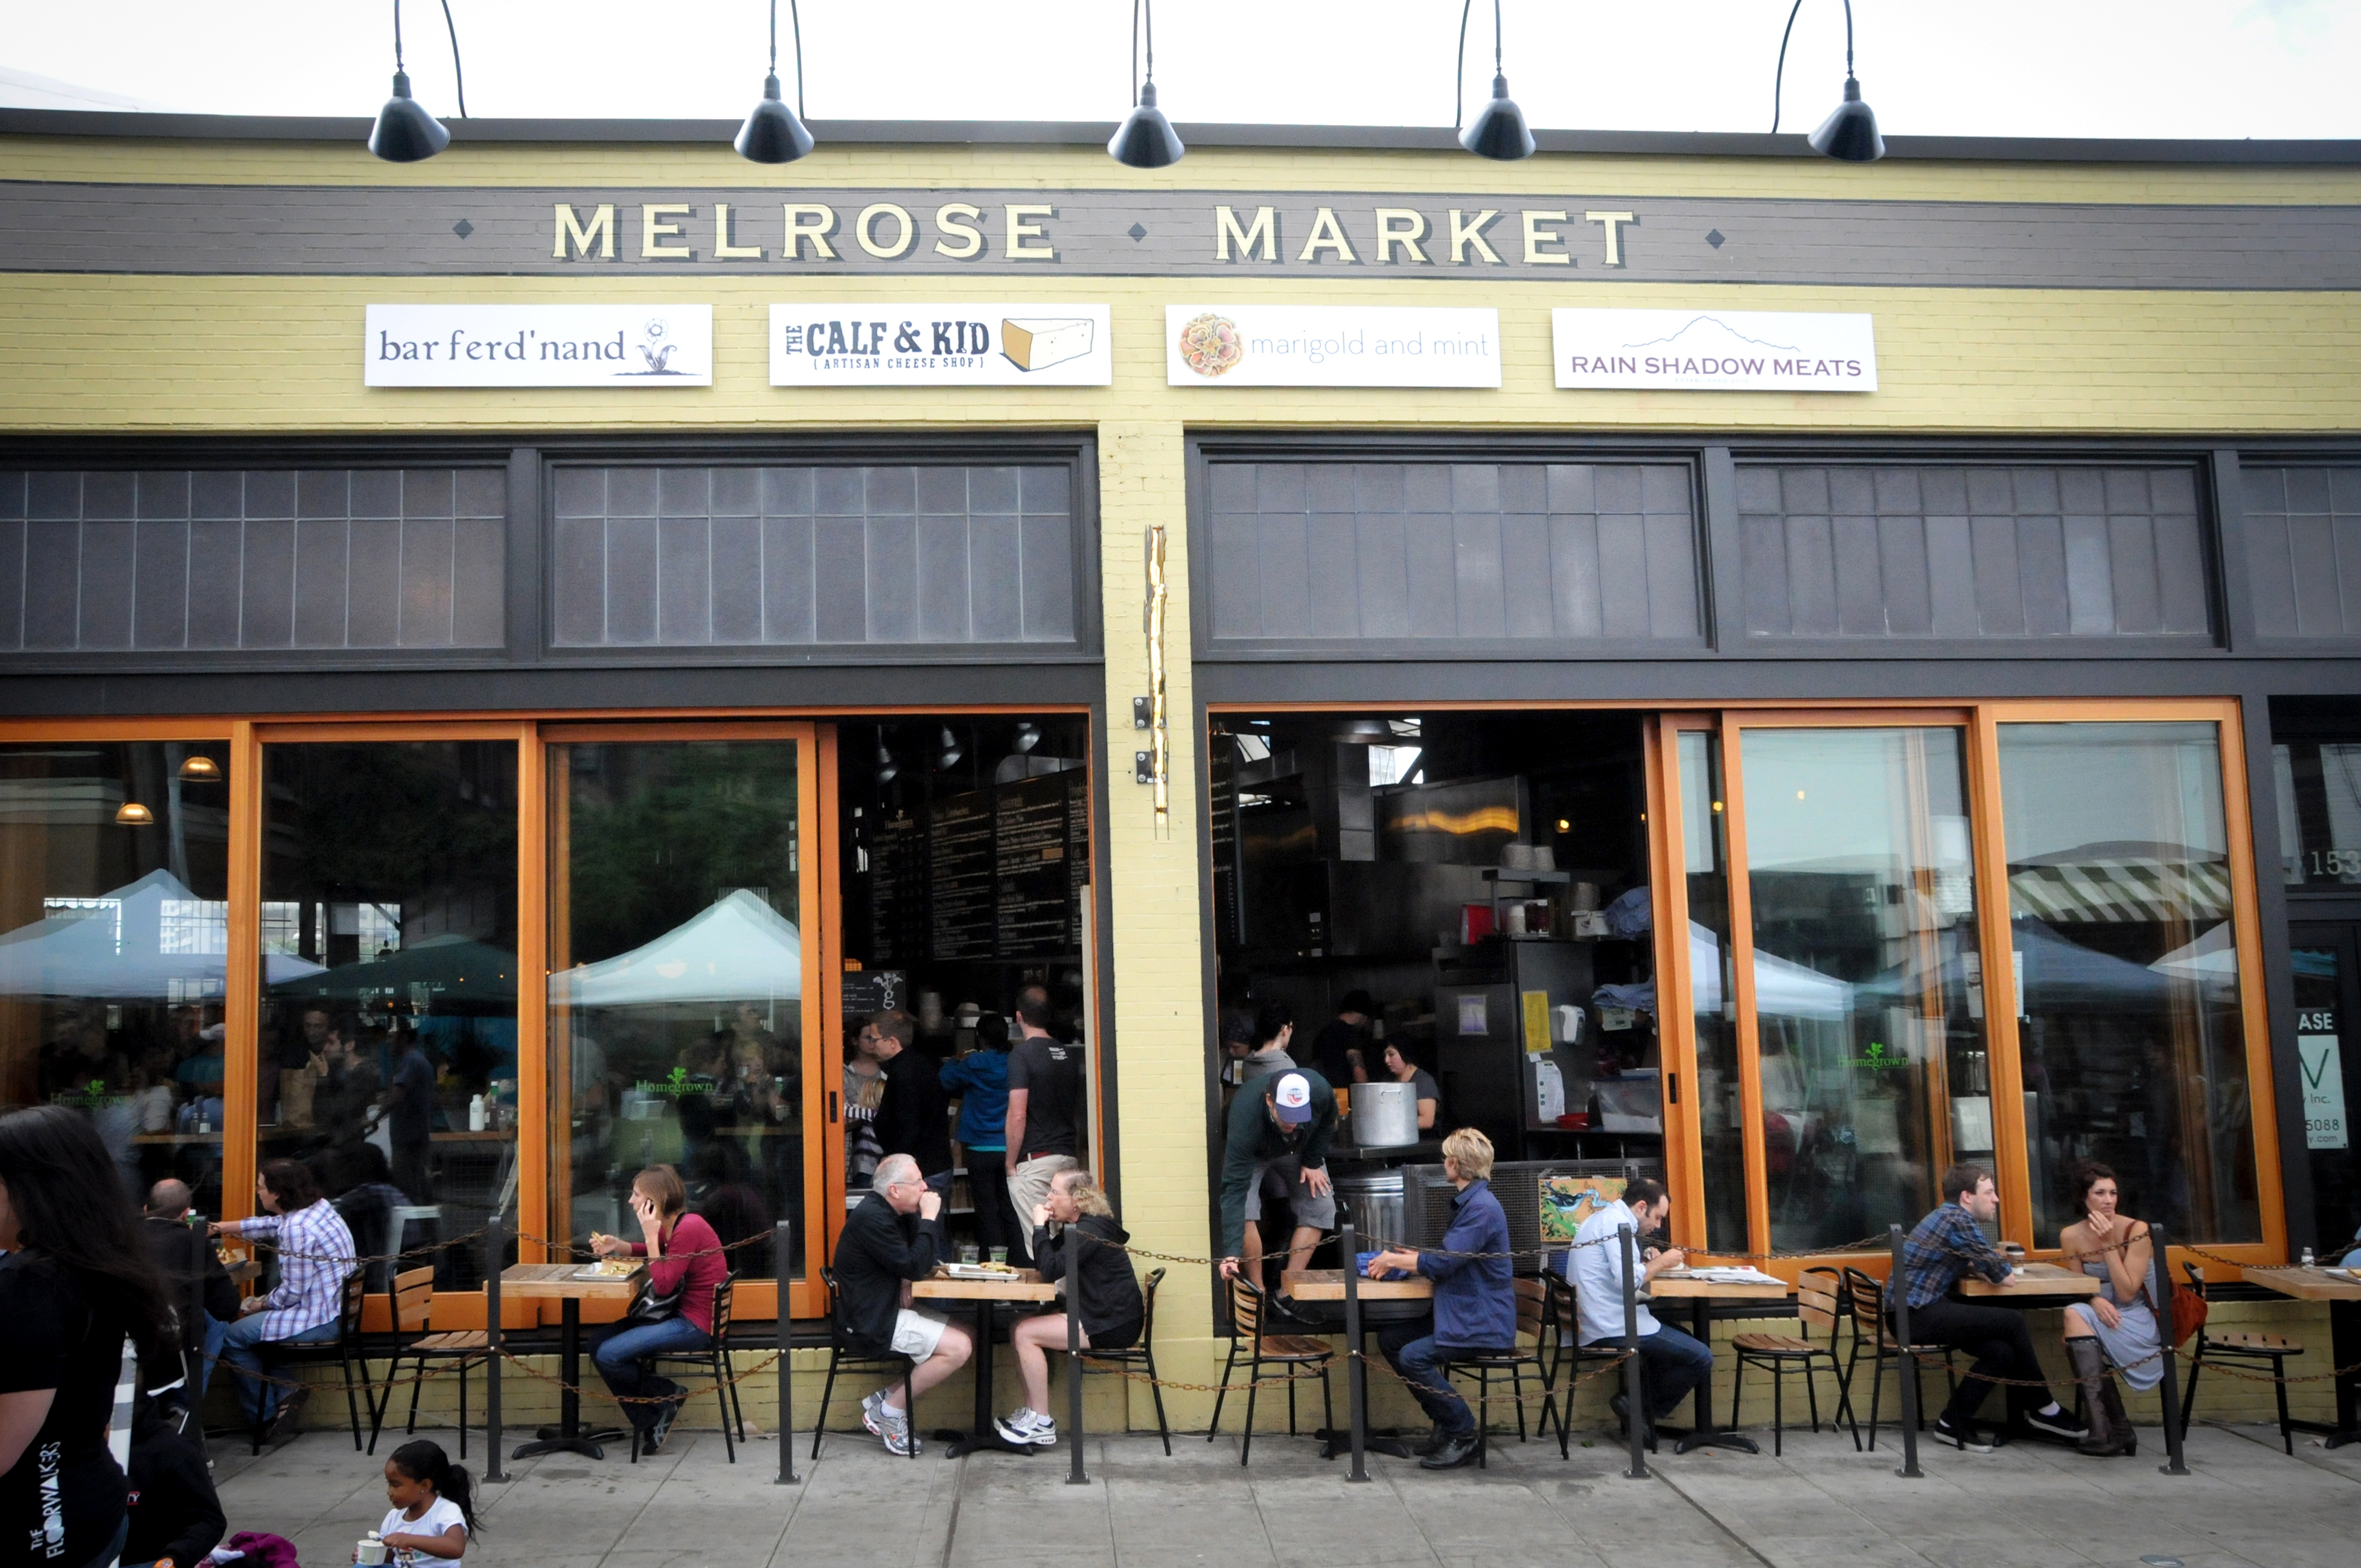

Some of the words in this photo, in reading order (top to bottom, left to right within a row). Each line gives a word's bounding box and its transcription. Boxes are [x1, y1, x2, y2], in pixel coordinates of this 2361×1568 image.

[551, 202, 1058, 262] MELROSE
[1213, 205, 1638, 267] MARKET
[379, 329, 439, 360] bar
[449, 329, 626, 360] ferd'nand
[785, 325, 802, 355] THE
[807, 320, 887, 357] CALF
[893, 320, 922, 353] &
[931, 320, 990, 355] KID
[1252, 328, 1364, 363] marigold
[1375, 331, 1422, 355] and
[1434, 331, 1489, 355] mint
[824, 358, 880, 369] ARTISAN
[887, 357, 935, 369] CHEESE
[943, 357, 974, 368] SHOP
[1571, 356, 1637, 374] RAIN
[1644, 357, 1766, 375] SHADOW
[1773, 359, 1862, 377] MEATS
[1837, 1054, 1909, 1071] Homegrown
[636, 1079, 714, 1097] Homegrown
[2310, 1094, 2331, 1104] Inc.
[29, 1529, 44, 1550] THE
